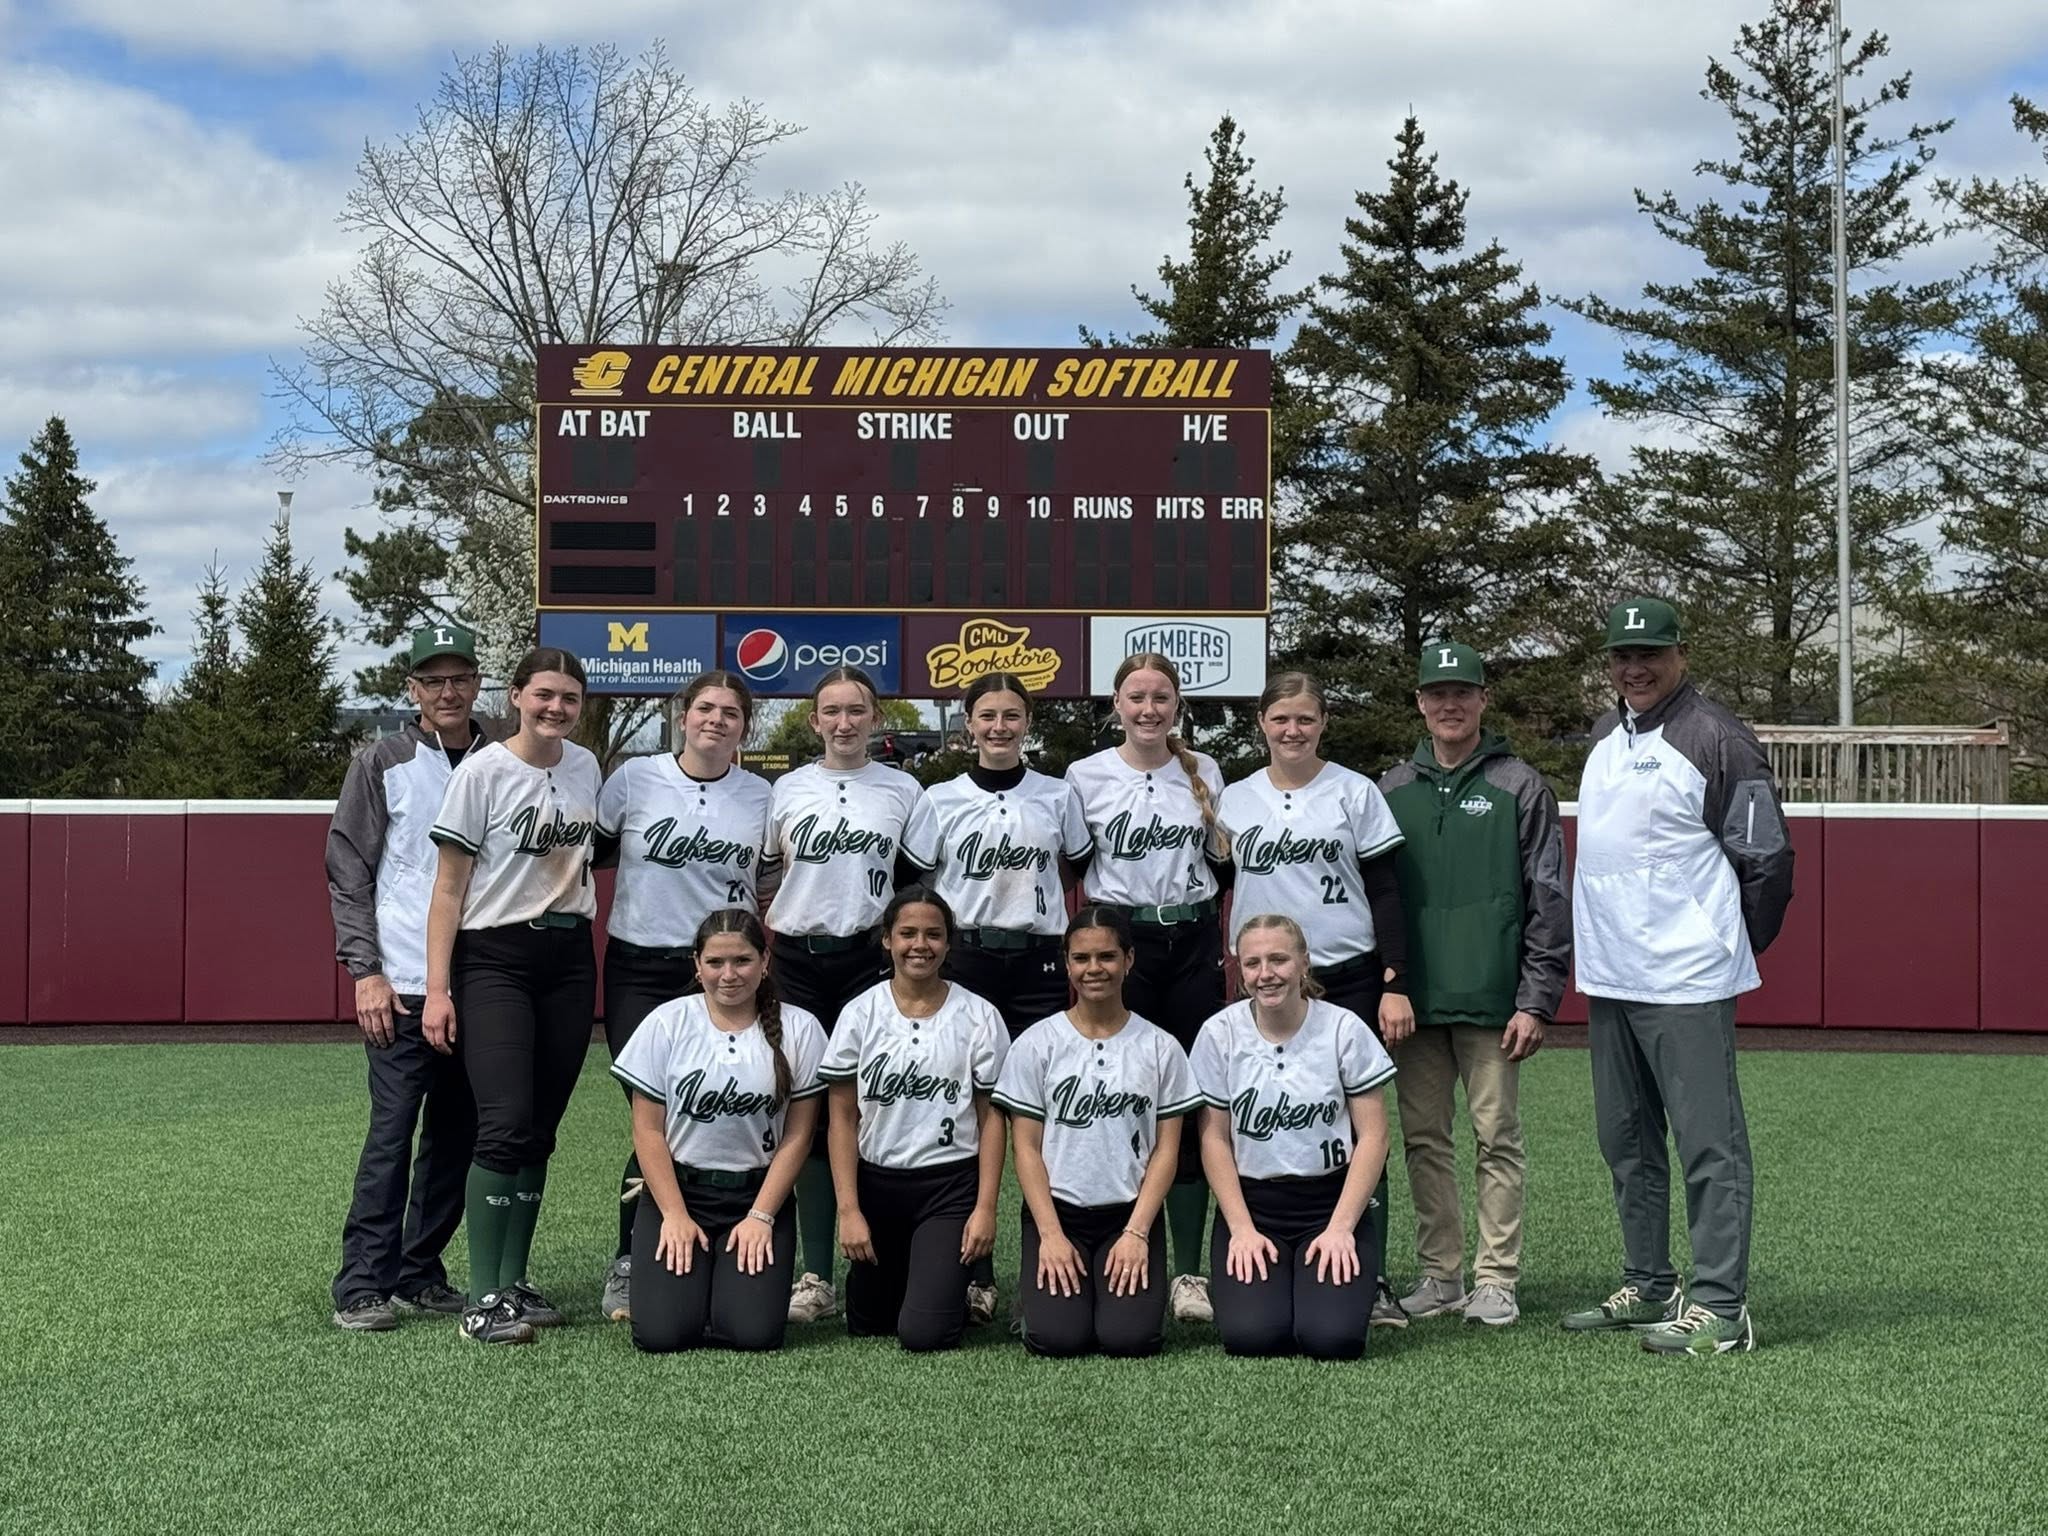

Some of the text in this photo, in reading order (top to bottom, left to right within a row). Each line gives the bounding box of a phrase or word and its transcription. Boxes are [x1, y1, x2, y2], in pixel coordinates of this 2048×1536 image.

[646, 355, 1240, 398] CENTRAL MICHIGAN SOFTBALL
[558, 410, 651, 437] AT BAT
[733, 411, 802, 439] BALL
[857, 412, 953, 440] STRIKE
[1013, 413, 1070, 441] OUT
[1182, 414, 1228, 444] H/E
[543, 495, 628, 504] DAKTRONICS
[683, 494, 694, 516] 1
[717, 494, 730, 516] 2
[754, 494, 767, 517] 3
[799, 495, 812, 517] 4
[835, 495, 848, 517] 5
[871, 495, 884, 517] 6
[917, 496, 929, 518] 7
[952, 496, 964, 518] 8
[988, 496, 1000, 518] 9
[1026, 497, 1051, 519] 10
[1073, 496, 1133, 519] RUNS
[1156, 497, 1206, 519] HITS
[1221, 498, 1265, 520] ERR
[1624, 607, 1646, 630] L
[433, 628, 453, 646] L
[607, 622, 649, 652] M
[969, 627, 1009, 647] CMU
[1132, 629, 1224, 658] MEMBERS
[580, 658, 702, 677] Michigan Health
[795, 640, 888, 672] pepsi
[930, 646, 1057, 684] Bookstore
[1438, 648, 1458, 668] L
[510, 805, 596, 857] Laker
[642, 816, 755, 869] Lakers
[790, 813, 894, 864] Lakers
[956, 830, 1051, 881] Lakers
[1236, 824, 1344, 876] Lakers
[867, 867, 888, 898] 10
[1320, 874, 1349, 904] 22
[861, 1052, 962, 1107] Lakers
[1052, 1074, 1153, 1129] Lakers
[1232, 1087, 1340, 1142] Lakers
[938, 1117, 955, 1147] 3
[1319, 1138, 1347, 1170] 16
